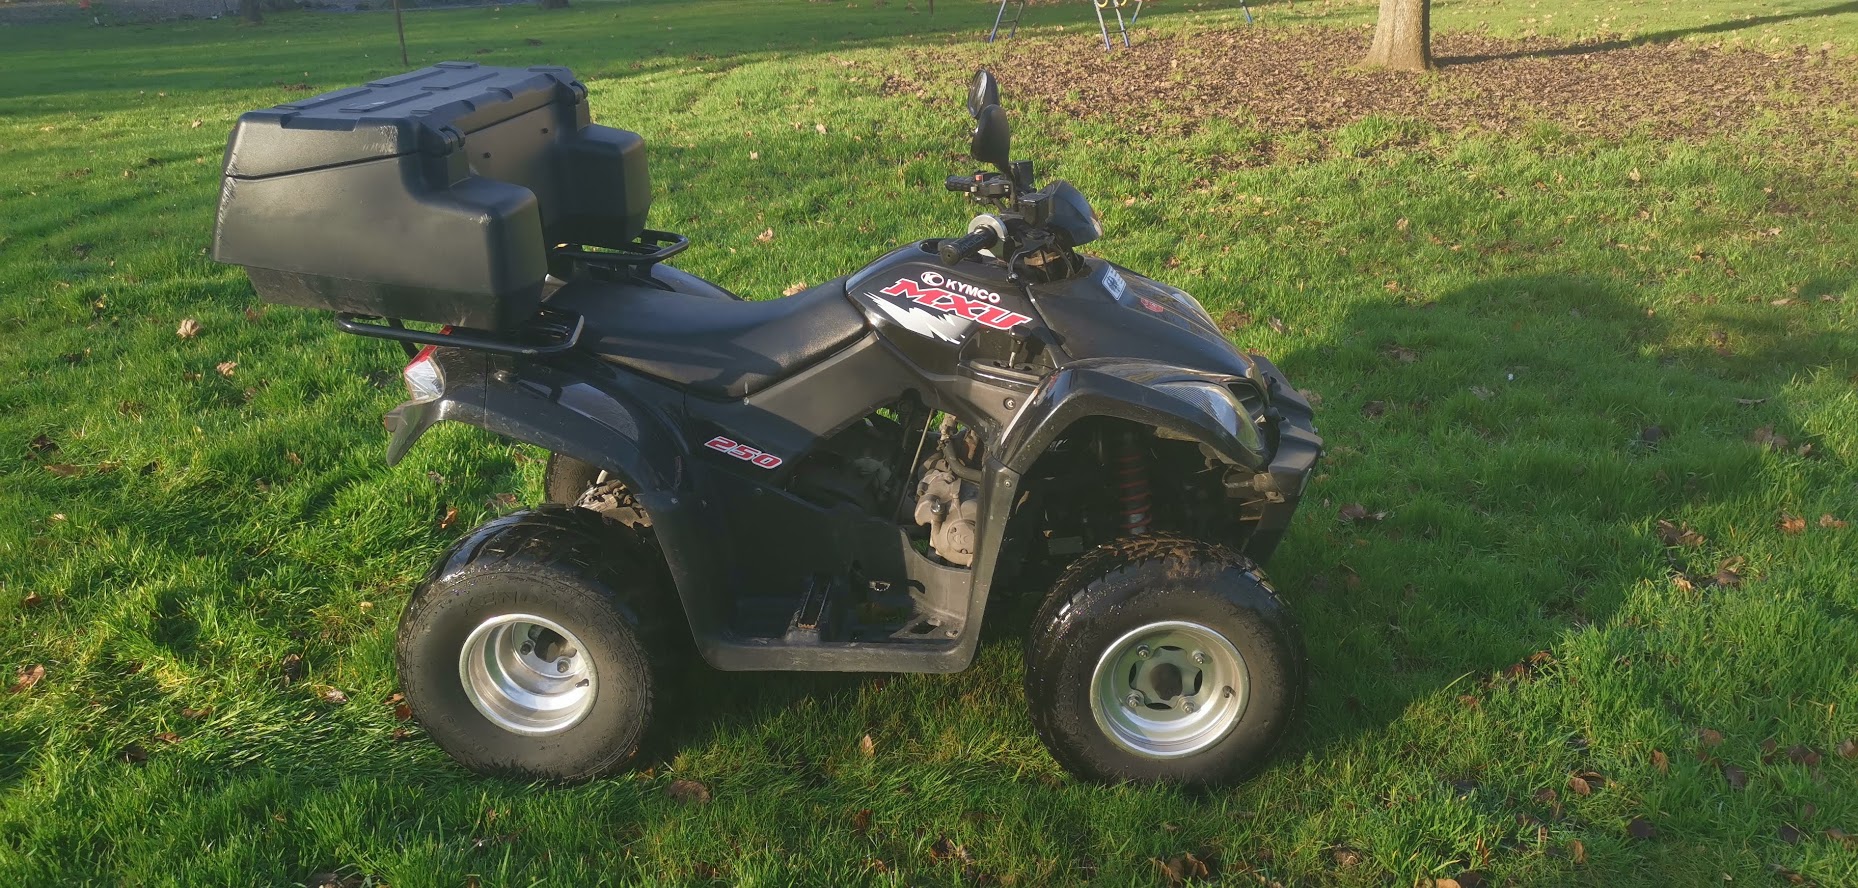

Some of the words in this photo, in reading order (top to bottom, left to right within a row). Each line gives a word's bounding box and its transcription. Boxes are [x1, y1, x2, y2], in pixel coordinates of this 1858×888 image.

[880, 277, 1033, 330] MXU
[945, 278, 1001, 303] KYMCO
[704, 435, 783, 469] 250
